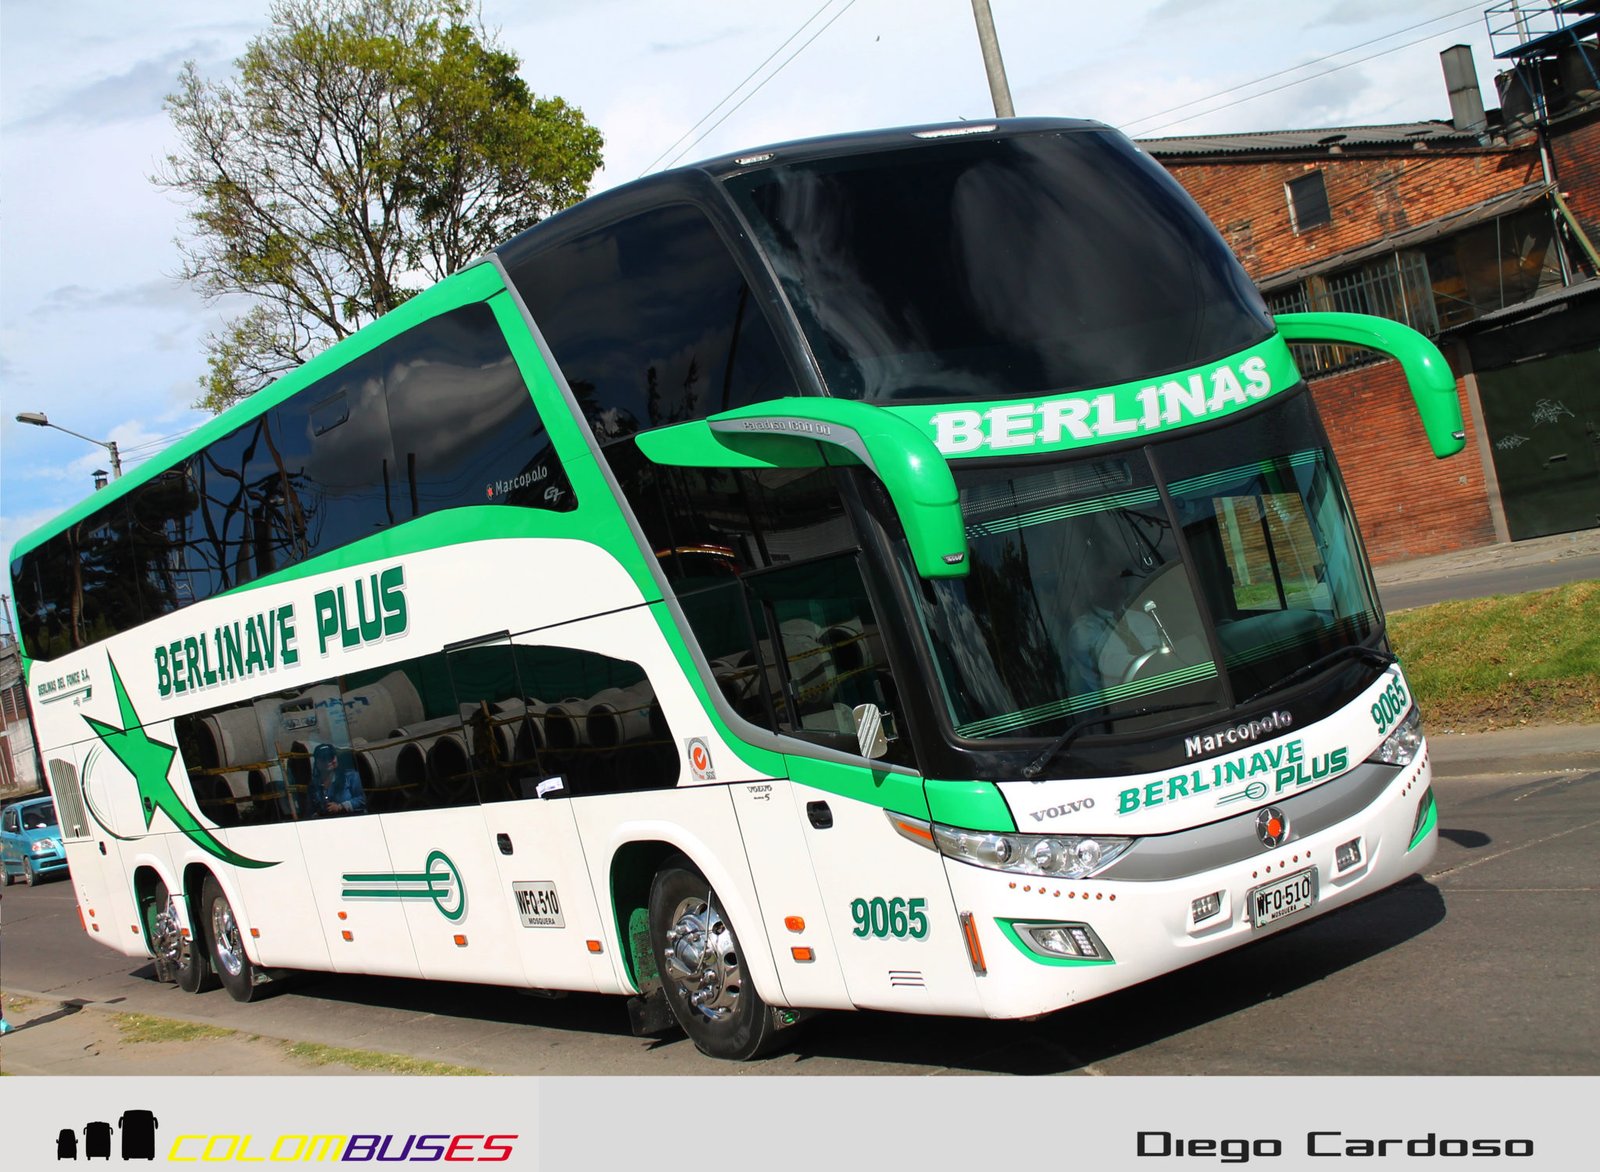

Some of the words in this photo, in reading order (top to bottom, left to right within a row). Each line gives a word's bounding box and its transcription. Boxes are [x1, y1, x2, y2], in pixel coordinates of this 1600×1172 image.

[743, 420, 786, 431] Paradiso
[931, 356, 1272, 455] BERLINAS
[495, 465, 548, 496] Marcopolo
[154, 602, 301, 700] BERLINAVE
[314, 565, 409, 657] PLUS
[1371, 674, 1407, 734] 9065
[1184, 710, 1294, 758] Marcopolo
[746, 784, 773, 793] VOLVO
[1114, 739, 1306, 816] BERLINAVE
[1275, 746, 1349, 794] PLUS
[1029, 797, 1095, 822] VOLVO
[528, 917, 556, 925] MOSQUERA
[850, 896, 929, 941] 9065
